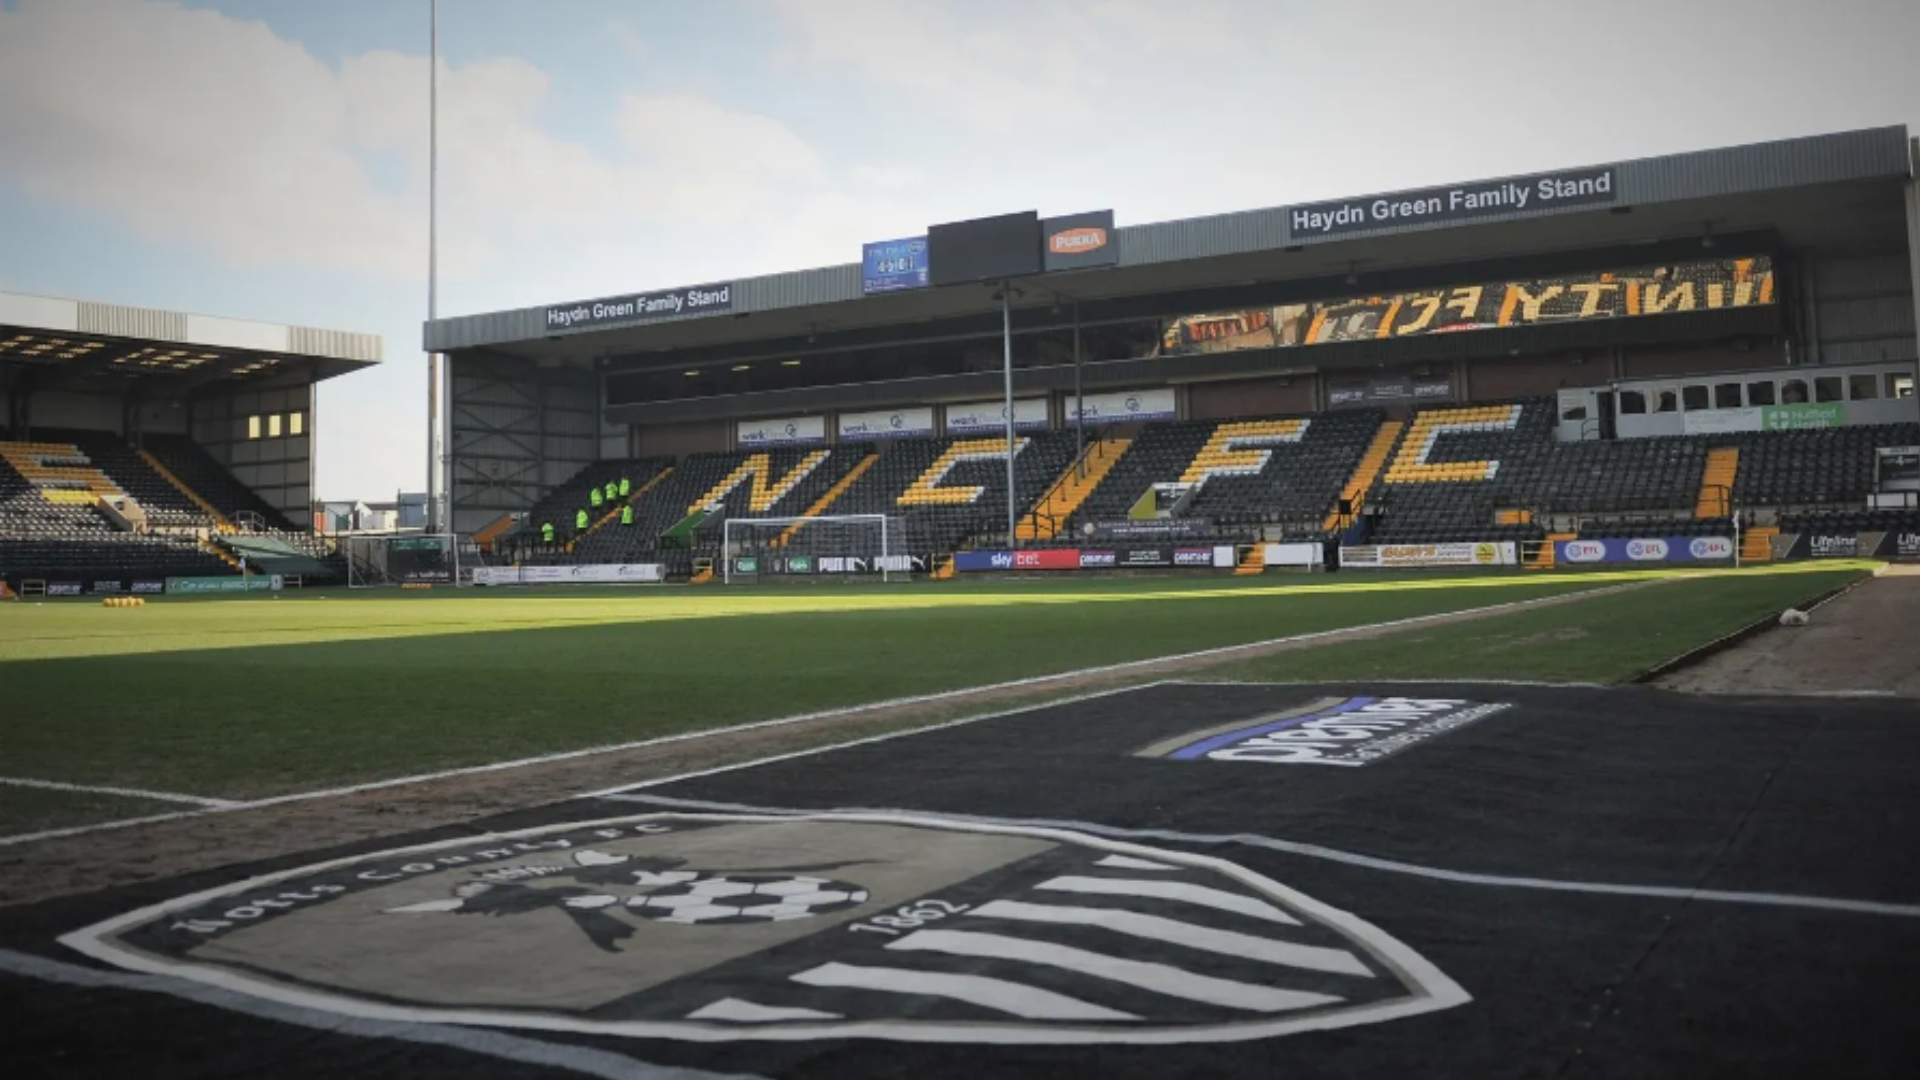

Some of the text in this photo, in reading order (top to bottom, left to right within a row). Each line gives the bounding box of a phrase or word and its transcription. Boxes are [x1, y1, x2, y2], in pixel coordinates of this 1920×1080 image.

[1293, 172, 1612, 231] Haydn Green Family Stand
[1055, 232, 1101, 249] PUKKA
[547, 287, 730, 326] Haydn Green Family Stand
[818, 556, 857, 572] PUMA
[991, 552, 1013, 568] sky
[1016, 553, 1041, 566] bet
[847, 899, 971, 935] 1862
